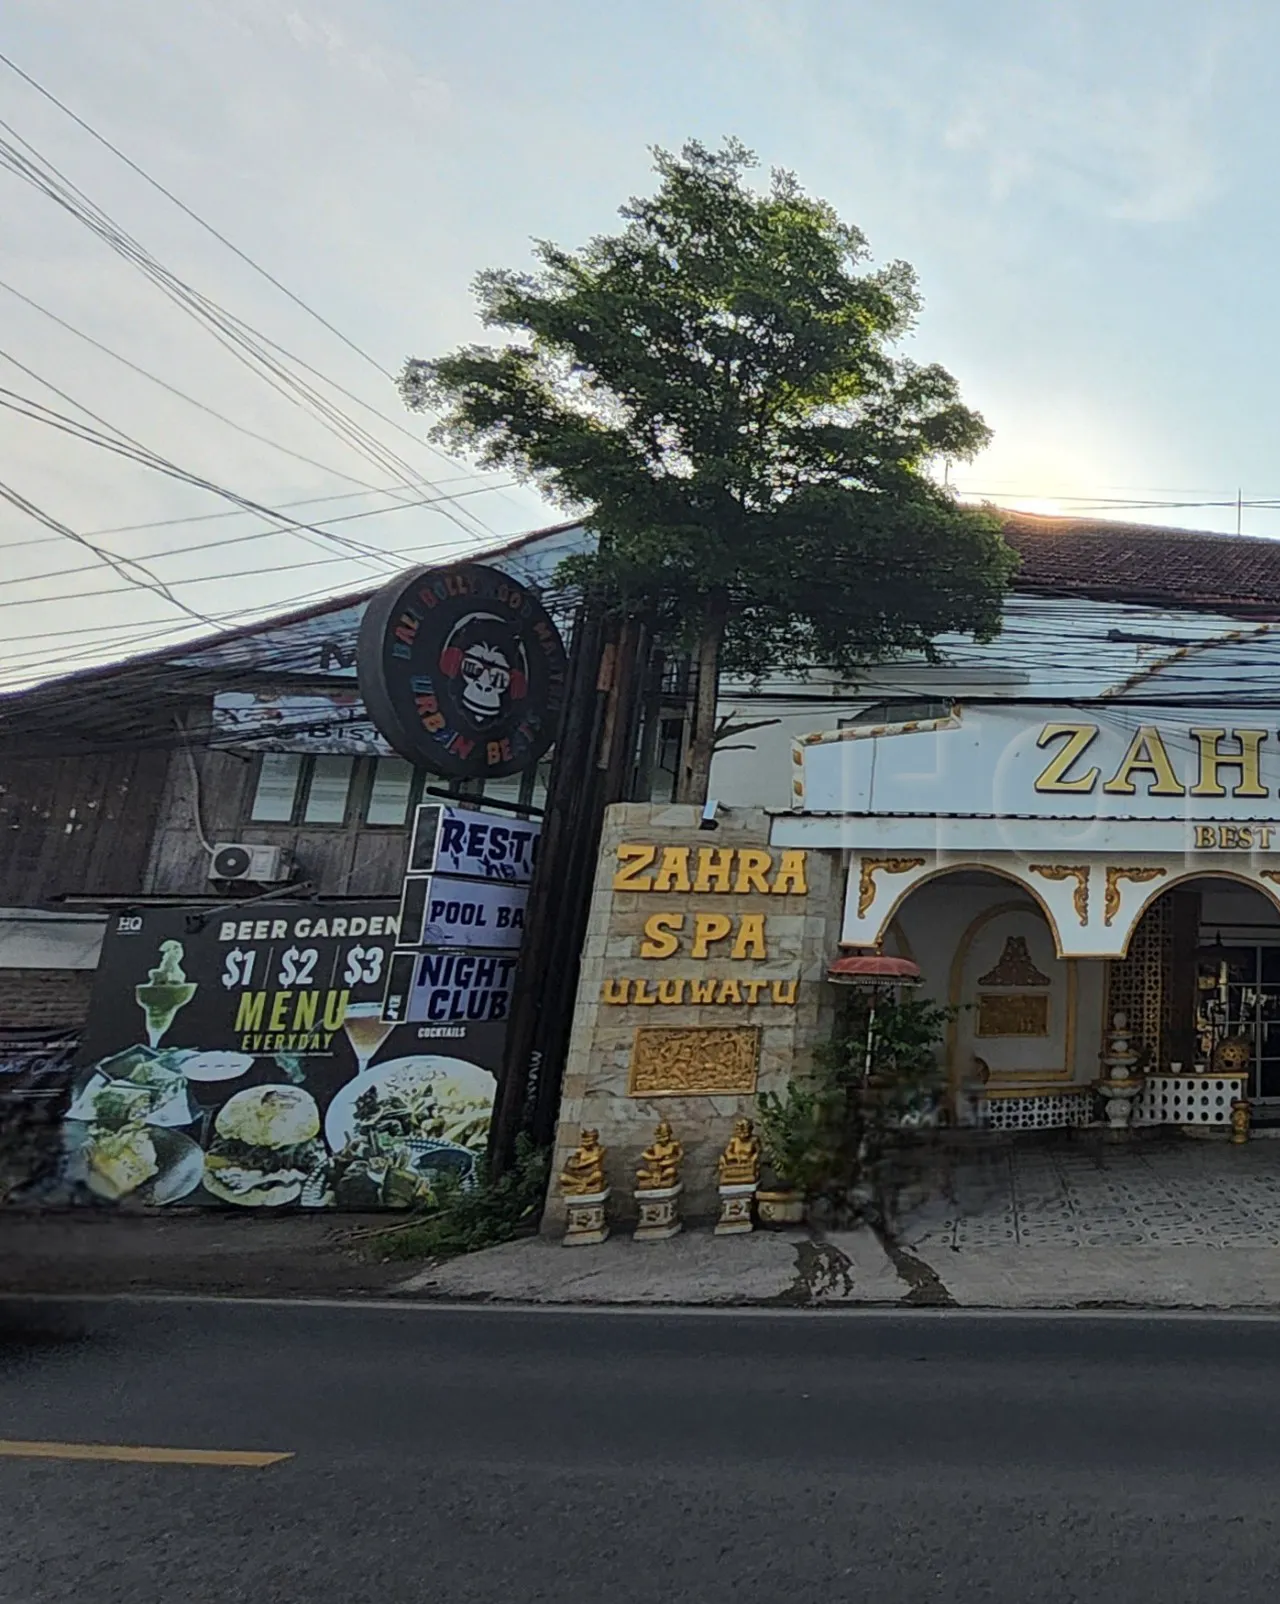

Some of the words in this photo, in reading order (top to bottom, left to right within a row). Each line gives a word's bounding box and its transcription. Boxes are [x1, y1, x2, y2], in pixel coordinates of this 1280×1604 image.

[1194, 825, 1277, 849] BEST
[613, 843, 809, 895] ZAHRA
[116, 916, 144, 931] HQ
[218, 919, 289, 941] BEER
[293, 916, 401, 938] GARDEN
[430, 900, 487, 927] POOL
[496, 907, 524, 930] BA
[640, 912, 768, 960] SPA
[221, 946, 256, 990] $1
[278, 945, 319, 989] $2
[343, 943, 385, 988] $3
[417, 955, 518, 988] NIGHT
[427, 990, 509, 1021] CLUB
[601, 979, 801, 1006] ULUWATU
[234, 990, 350, 1032] MENU
[241, 1034, 334, 1051] EVERYDAY
[417, 1027, 466, 1039] COCKTAILS
